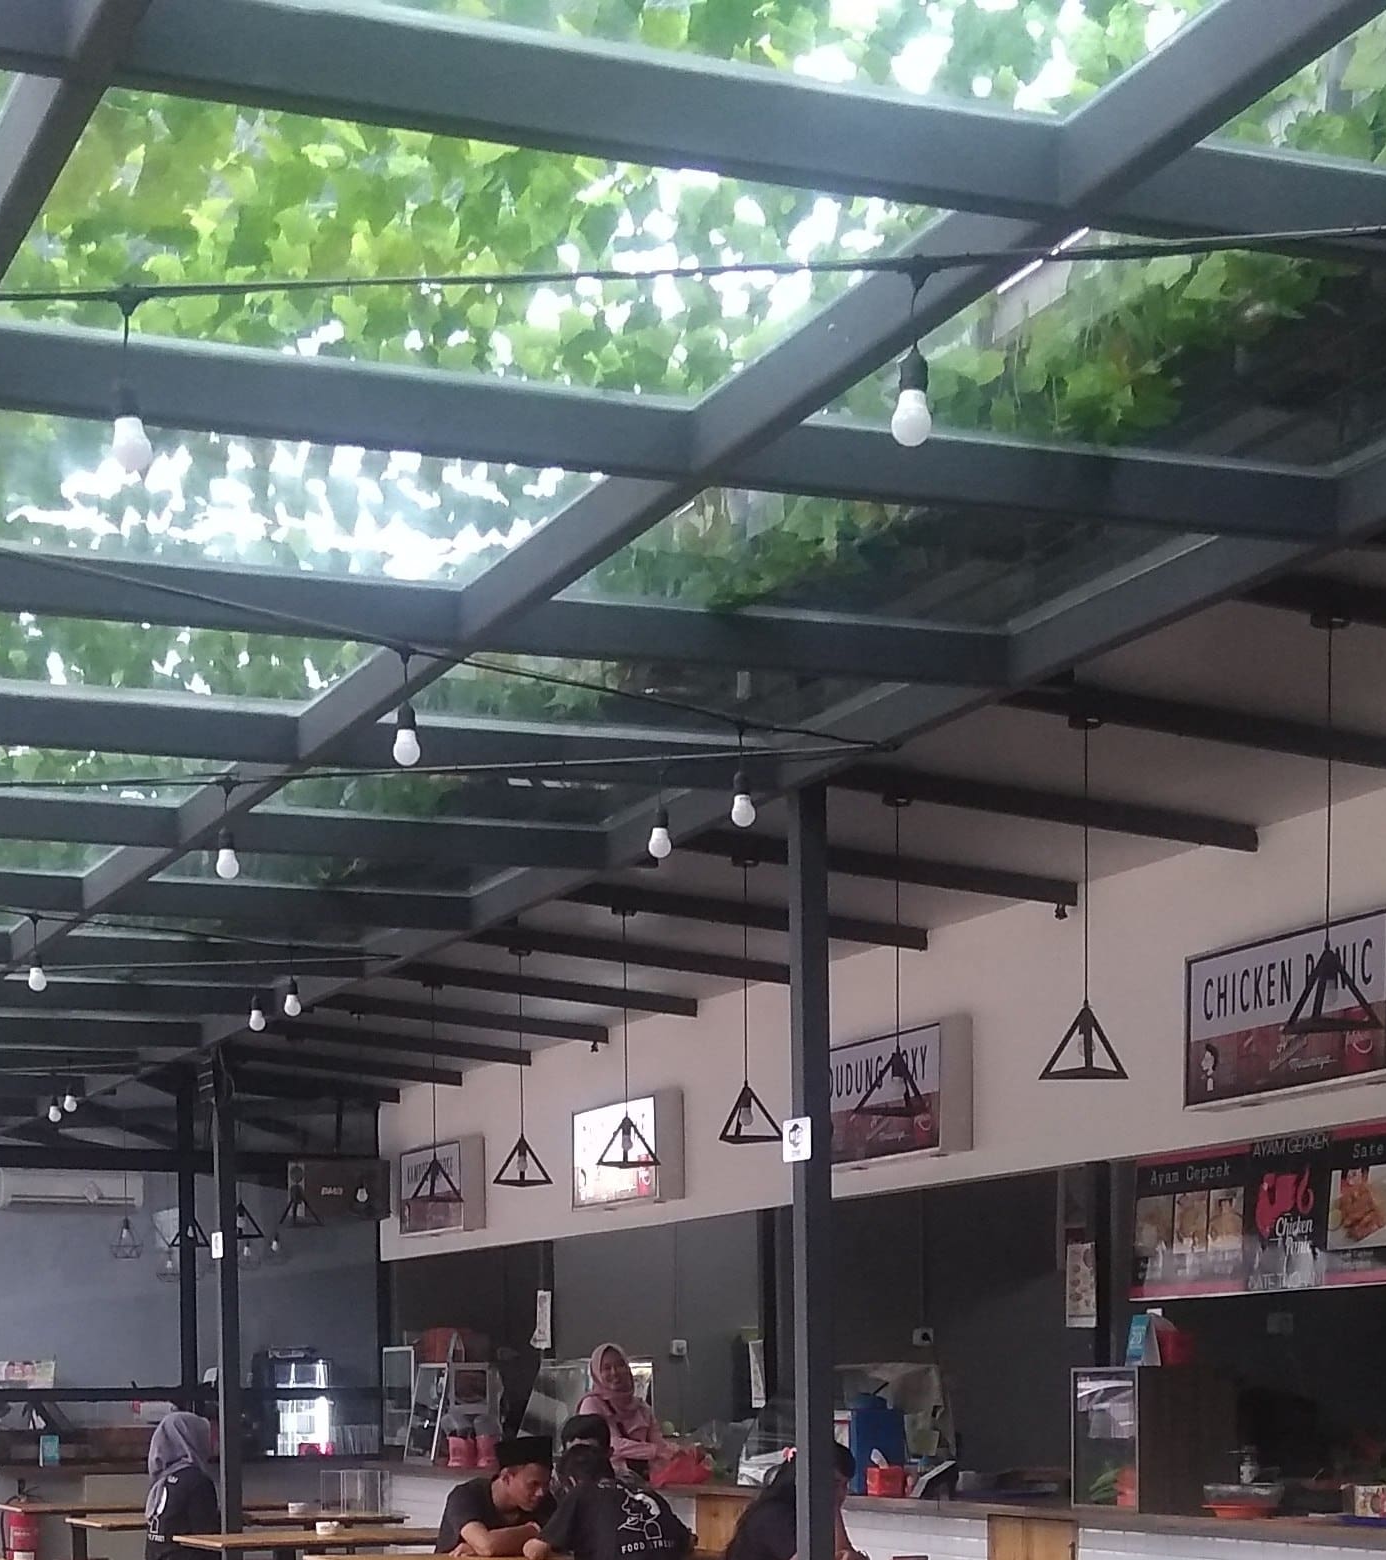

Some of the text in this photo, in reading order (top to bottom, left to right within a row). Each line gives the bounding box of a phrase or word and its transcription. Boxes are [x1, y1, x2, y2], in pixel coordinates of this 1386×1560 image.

[1203, 938, 1373, 1021] CHICKEN PNIC
[892, 1045, 928, 1080] OXY
[1253, 1139, 1286, 1157] AYAM
[1352, 1143, 1384, 1159] Sate
[1149, 1161, 1231, 1188] Ayam Geprek
[1274, 1214, 1314, 1238] Chicken
[1276, 1236, 1313, 1257] Panic
[621, 1541, 646, 1555] FOOD
